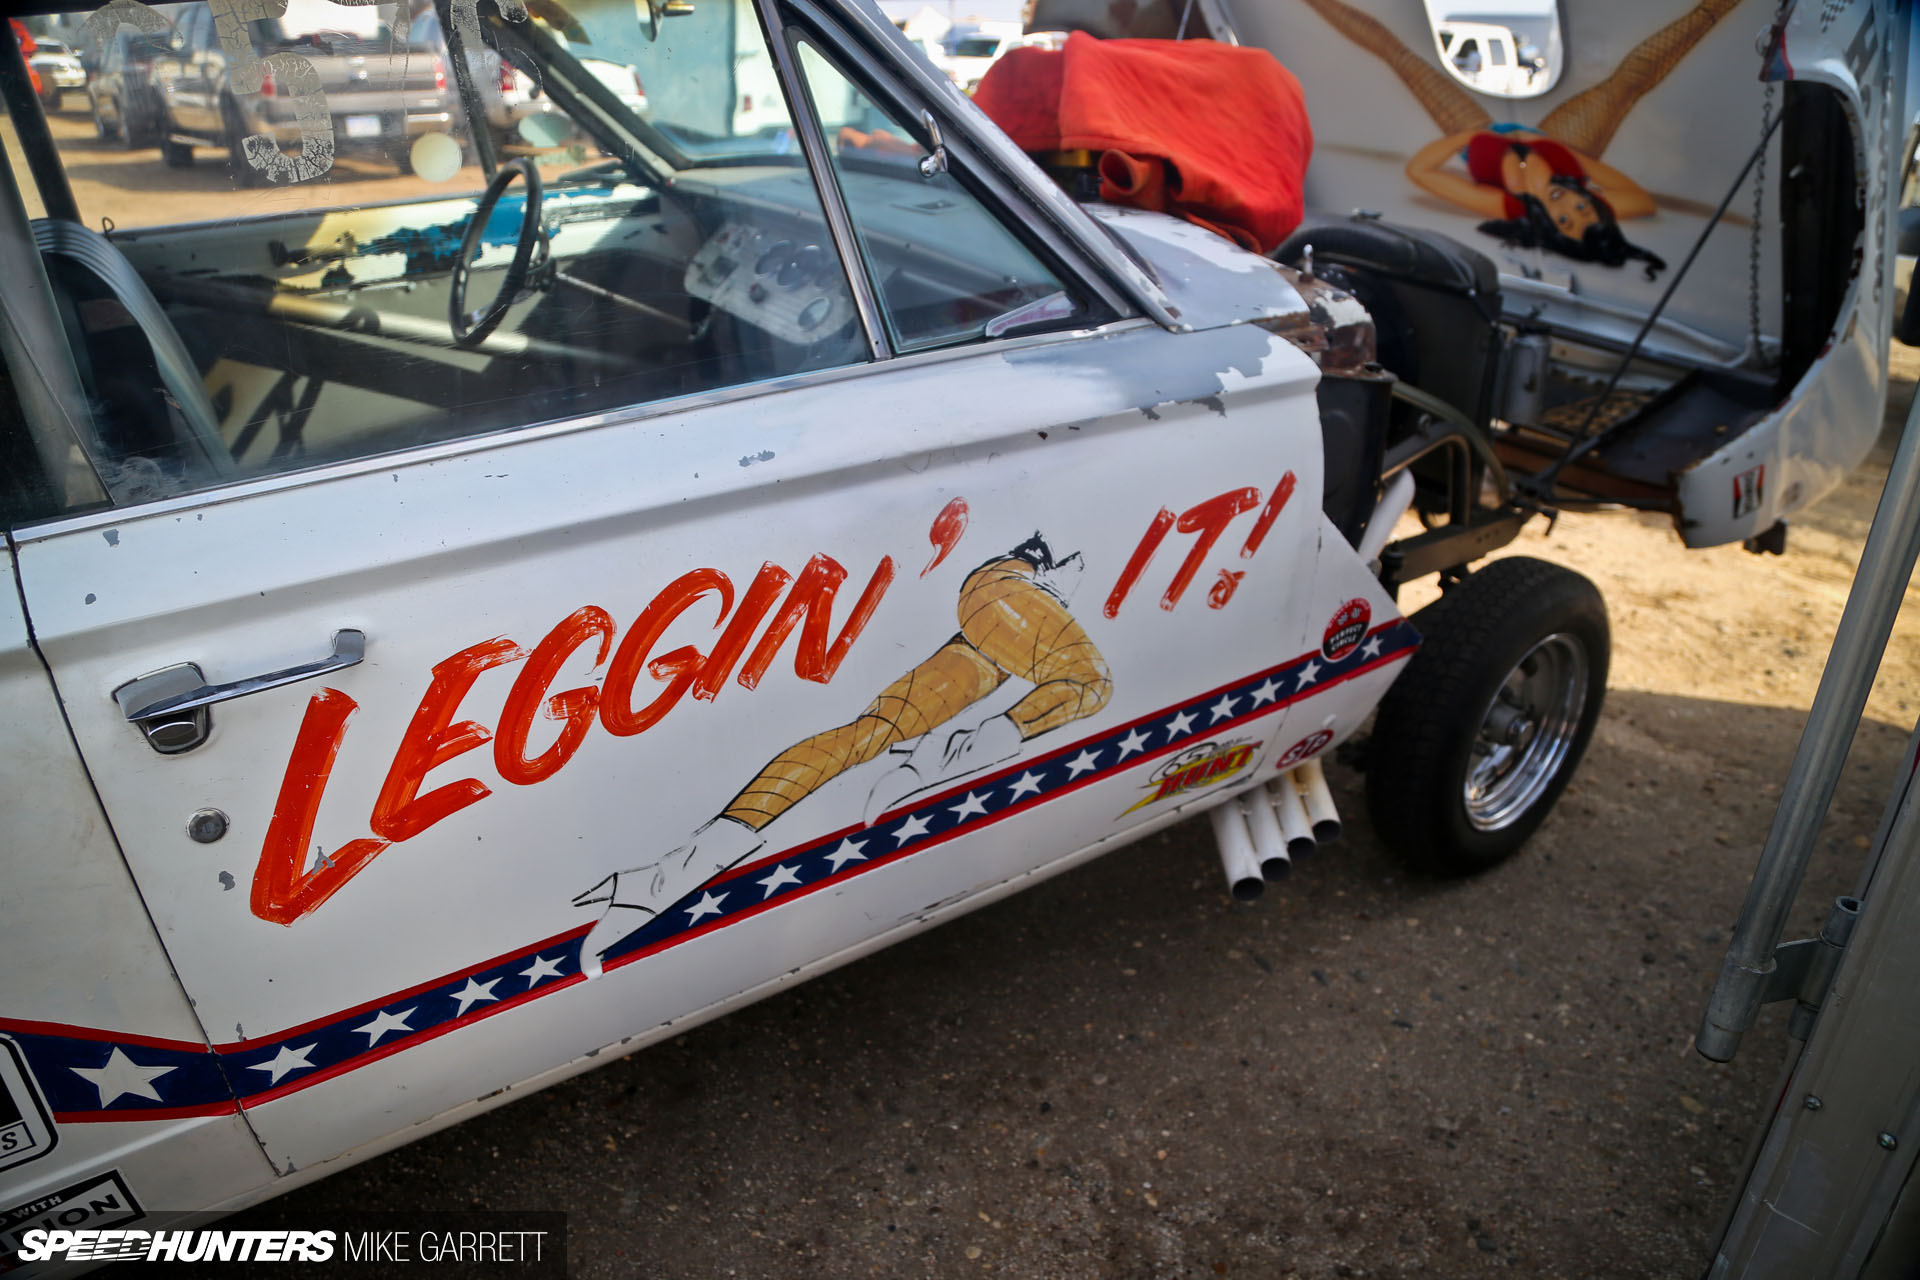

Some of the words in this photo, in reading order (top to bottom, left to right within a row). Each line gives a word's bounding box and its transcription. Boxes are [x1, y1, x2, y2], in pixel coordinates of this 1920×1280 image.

[249, 496, 968, 927] LEGGIN'
[1102, 469, 1297, 620] IT!
[1153, 741, 1264, 801] HUNT
[1281, 733, 1330, 765] STP
[12, 1195, 63, 1219] WITH
